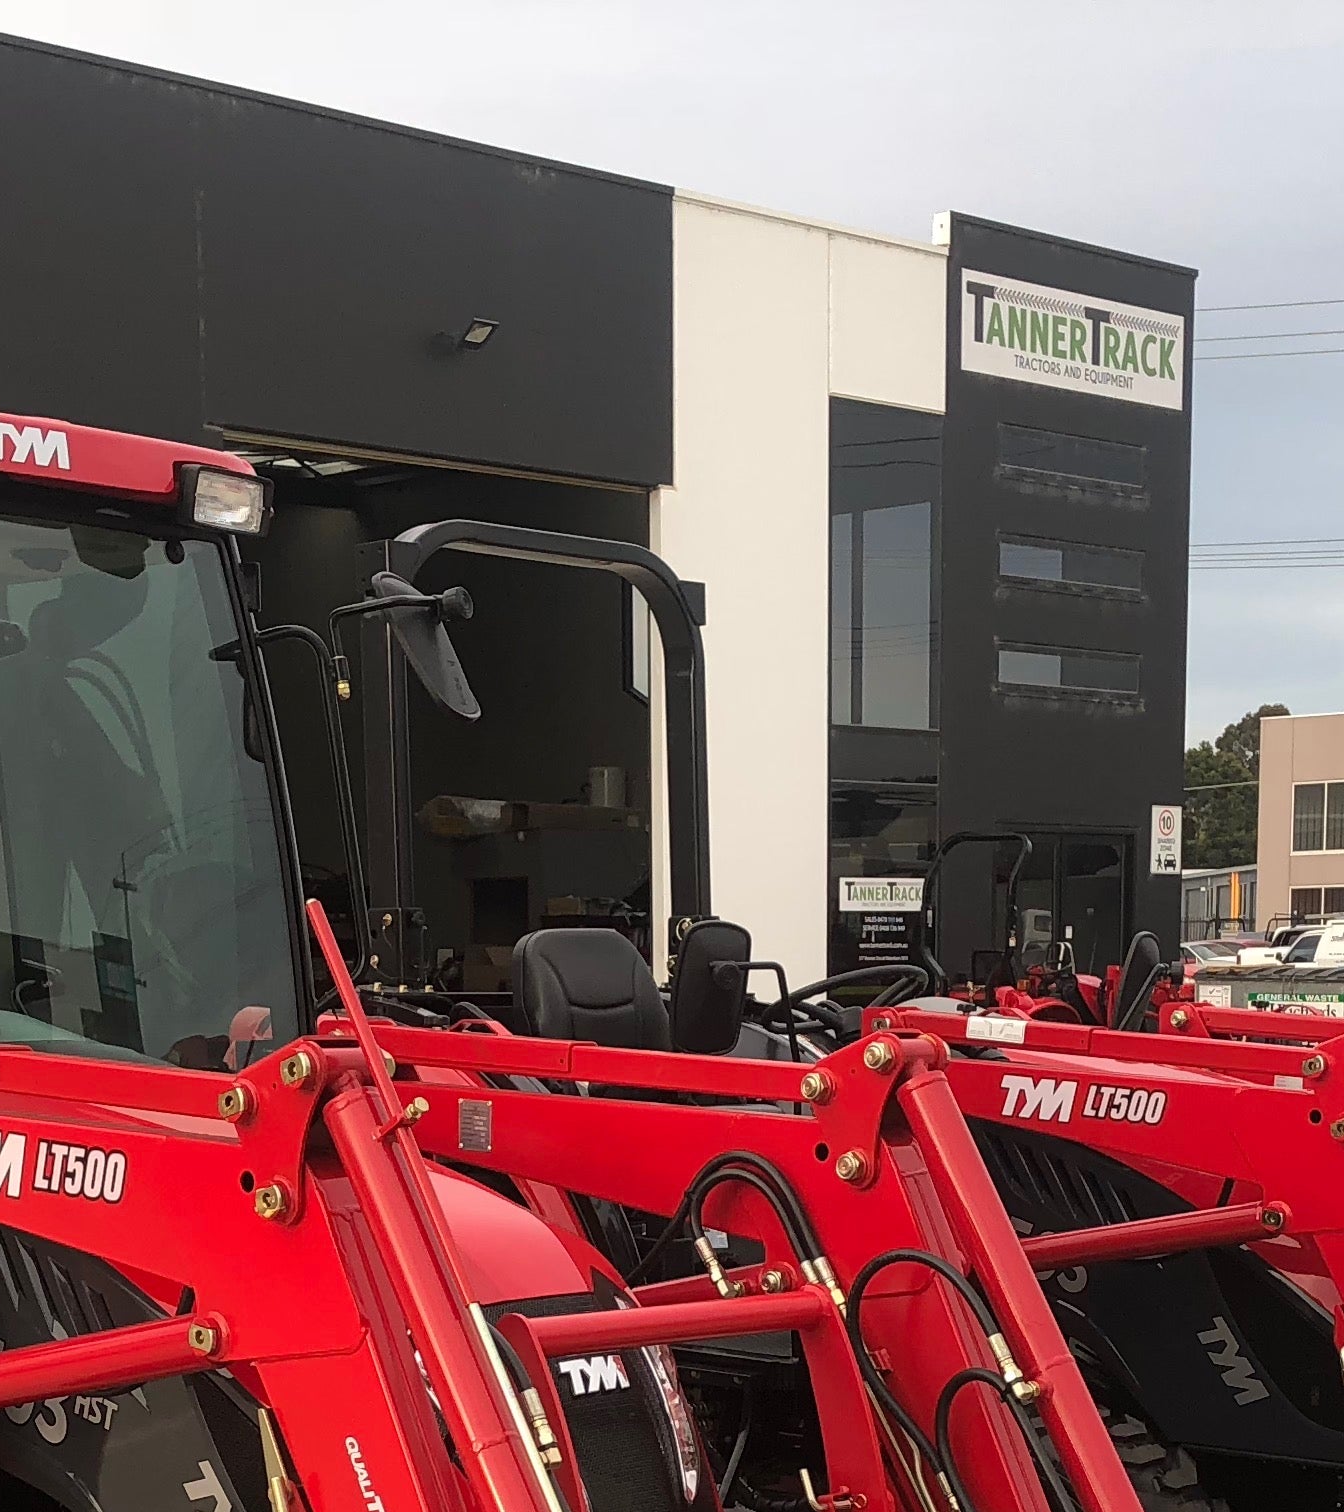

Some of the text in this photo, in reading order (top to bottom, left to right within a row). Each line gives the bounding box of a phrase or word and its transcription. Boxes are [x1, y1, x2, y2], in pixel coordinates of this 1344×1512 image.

[1014, 353, 1134, 390] TRACTORS AND EQUIPMENT
[1162, 815, 1172, 830] 10
[1257, 993, 1339, 1002] GENERAL WASTE
[1000, 1074, 1168, 1125] TYM LT500
[33, 1140, 127, 1204] LT500
[558, 1354, 630, 1396] TYM
[1197, 1316, 1270, 1406] TYM
[74, 1396, 118, 1430] HST
